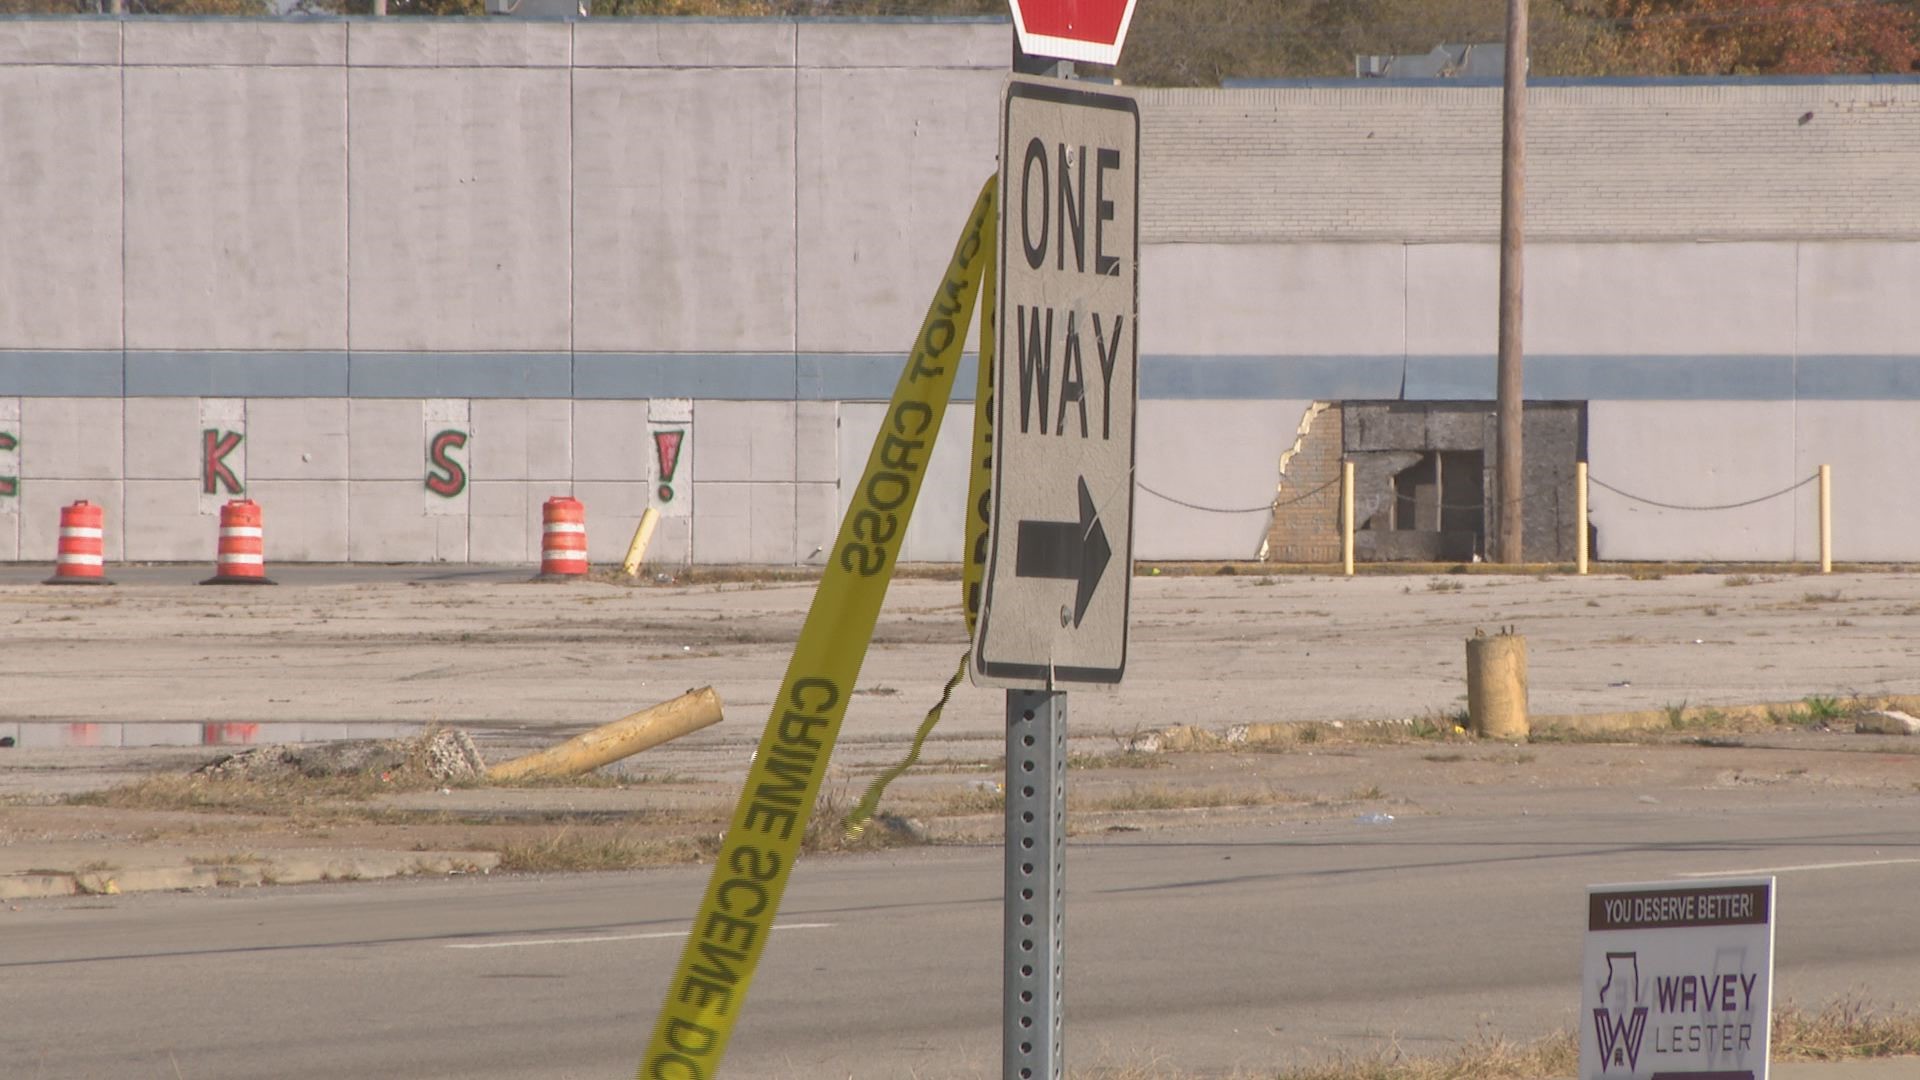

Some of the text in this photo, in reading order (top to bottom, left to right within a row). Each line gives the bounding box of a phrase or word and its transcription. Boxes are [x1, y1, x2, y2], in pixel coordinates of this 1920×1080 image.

[1021, 137, 1121, 277] ONE
[1017, 305, 1123, 440] WAY
[1605, 893, 1754, 923] YOU DESERVE BETTER!
[1657, 973, 1757, 1013] WAVEY
[1656, 1023, 1752, 1053] LESTER
